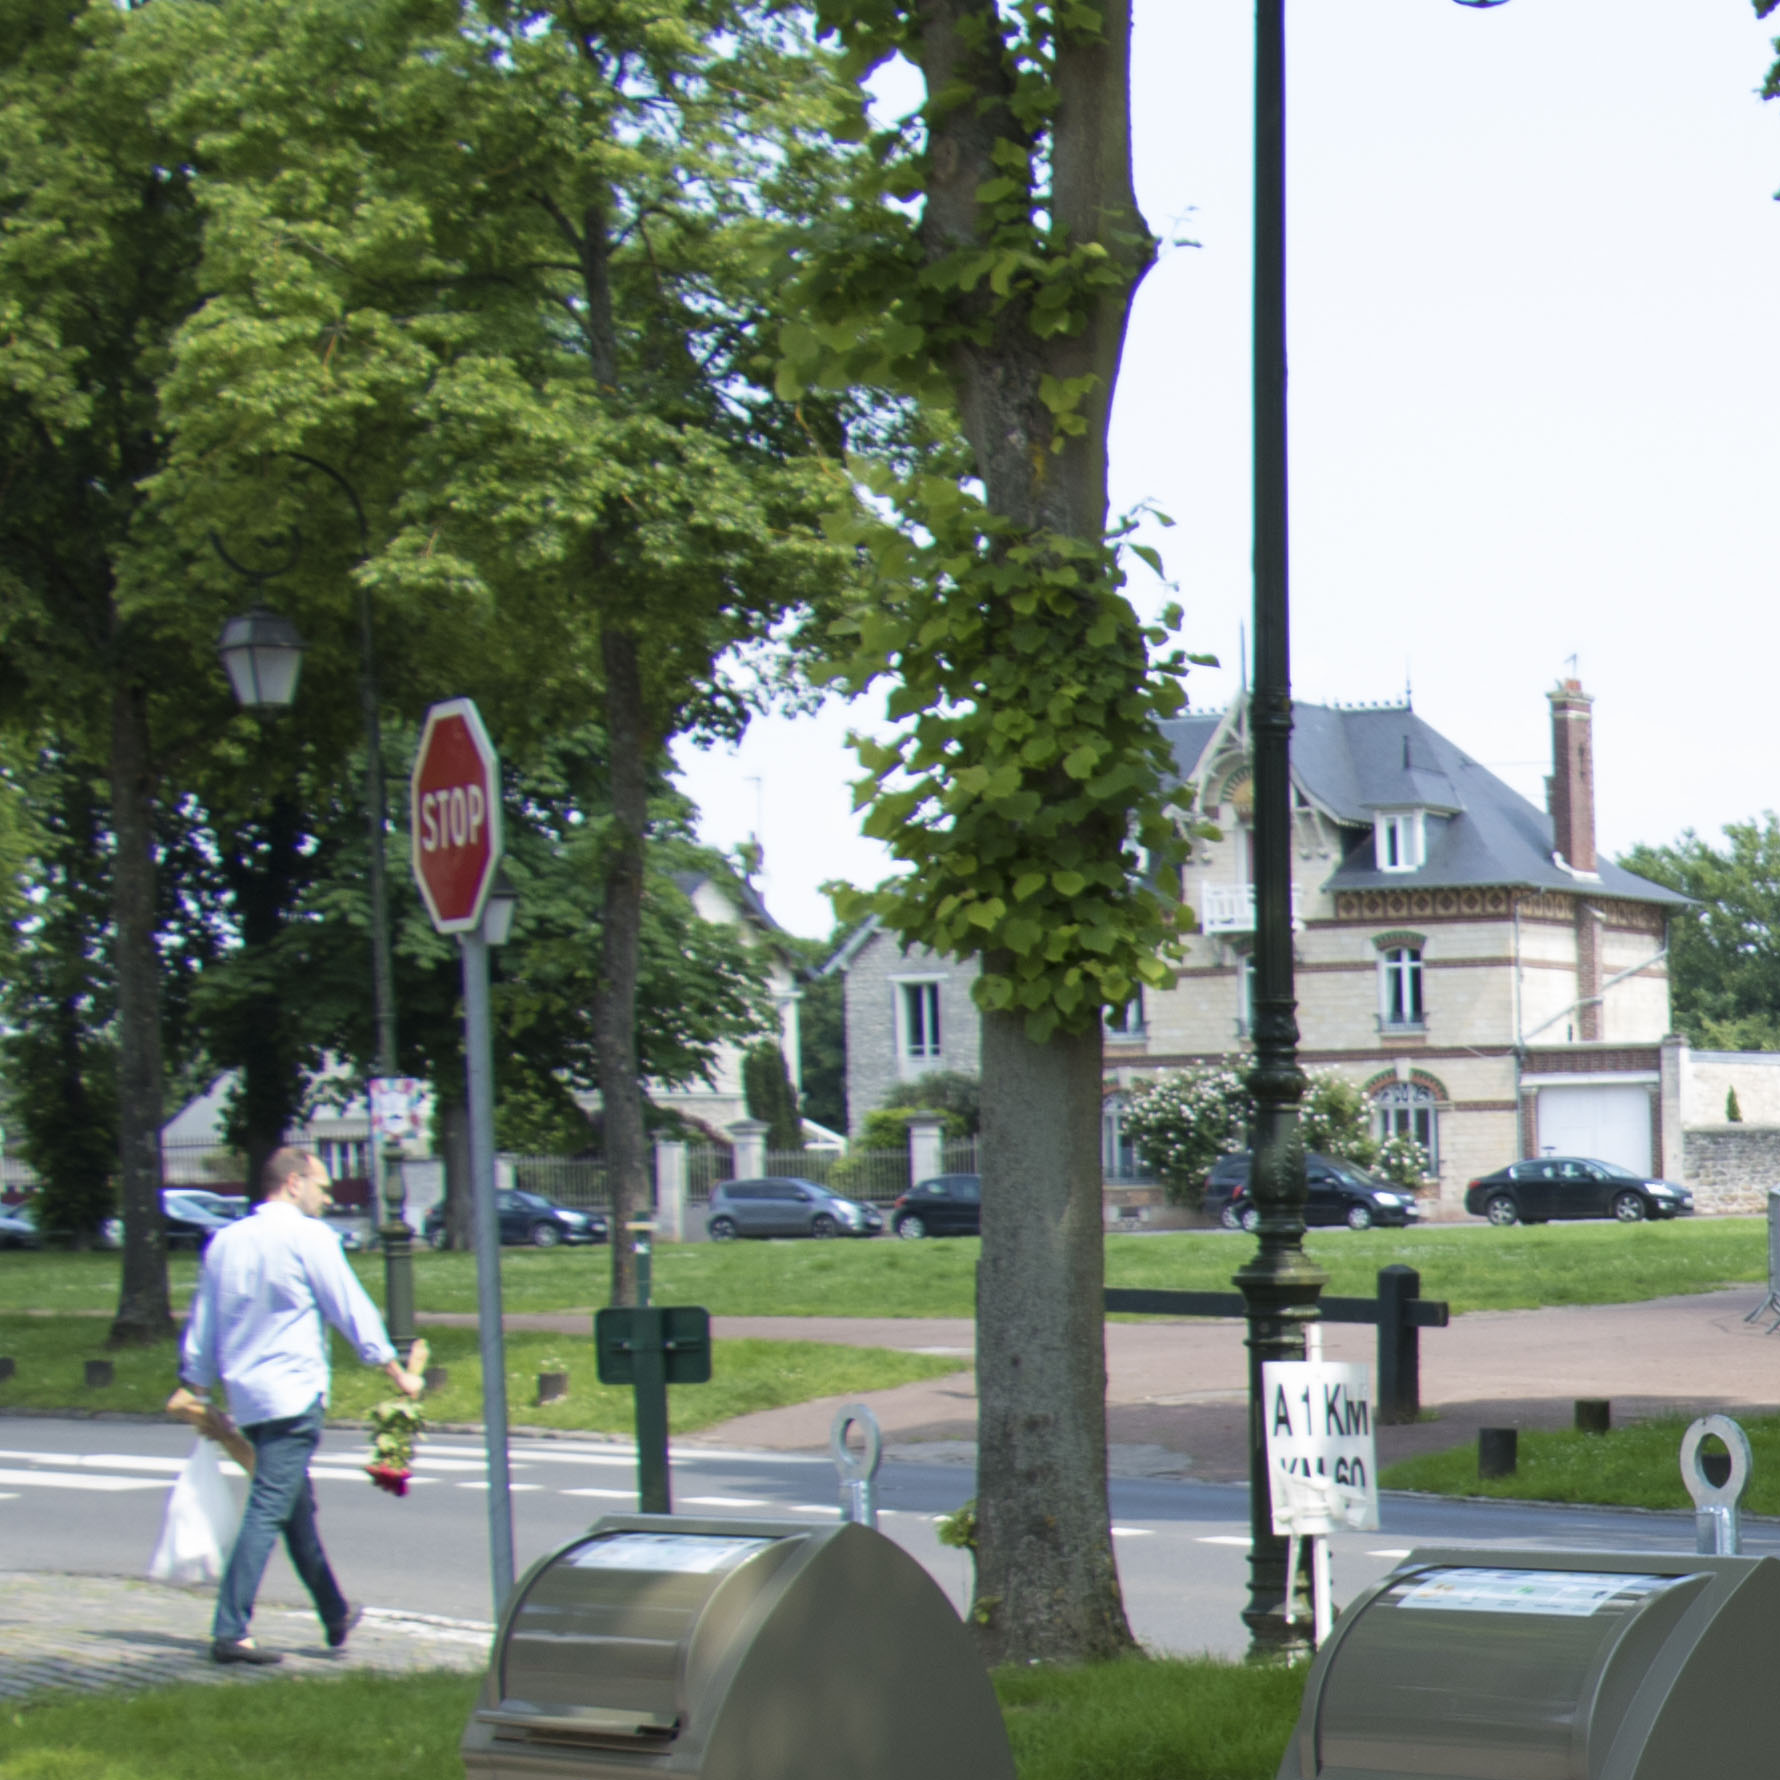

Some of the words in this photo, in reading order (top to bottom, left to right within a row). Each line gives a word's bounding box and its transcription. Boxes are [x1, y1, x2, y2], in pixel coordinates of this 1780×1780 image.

[422, 784, 485, 853] STOP
[1273, 1383, 1294, 1437] A
[1301, 1384, 1313, 1437] 1
